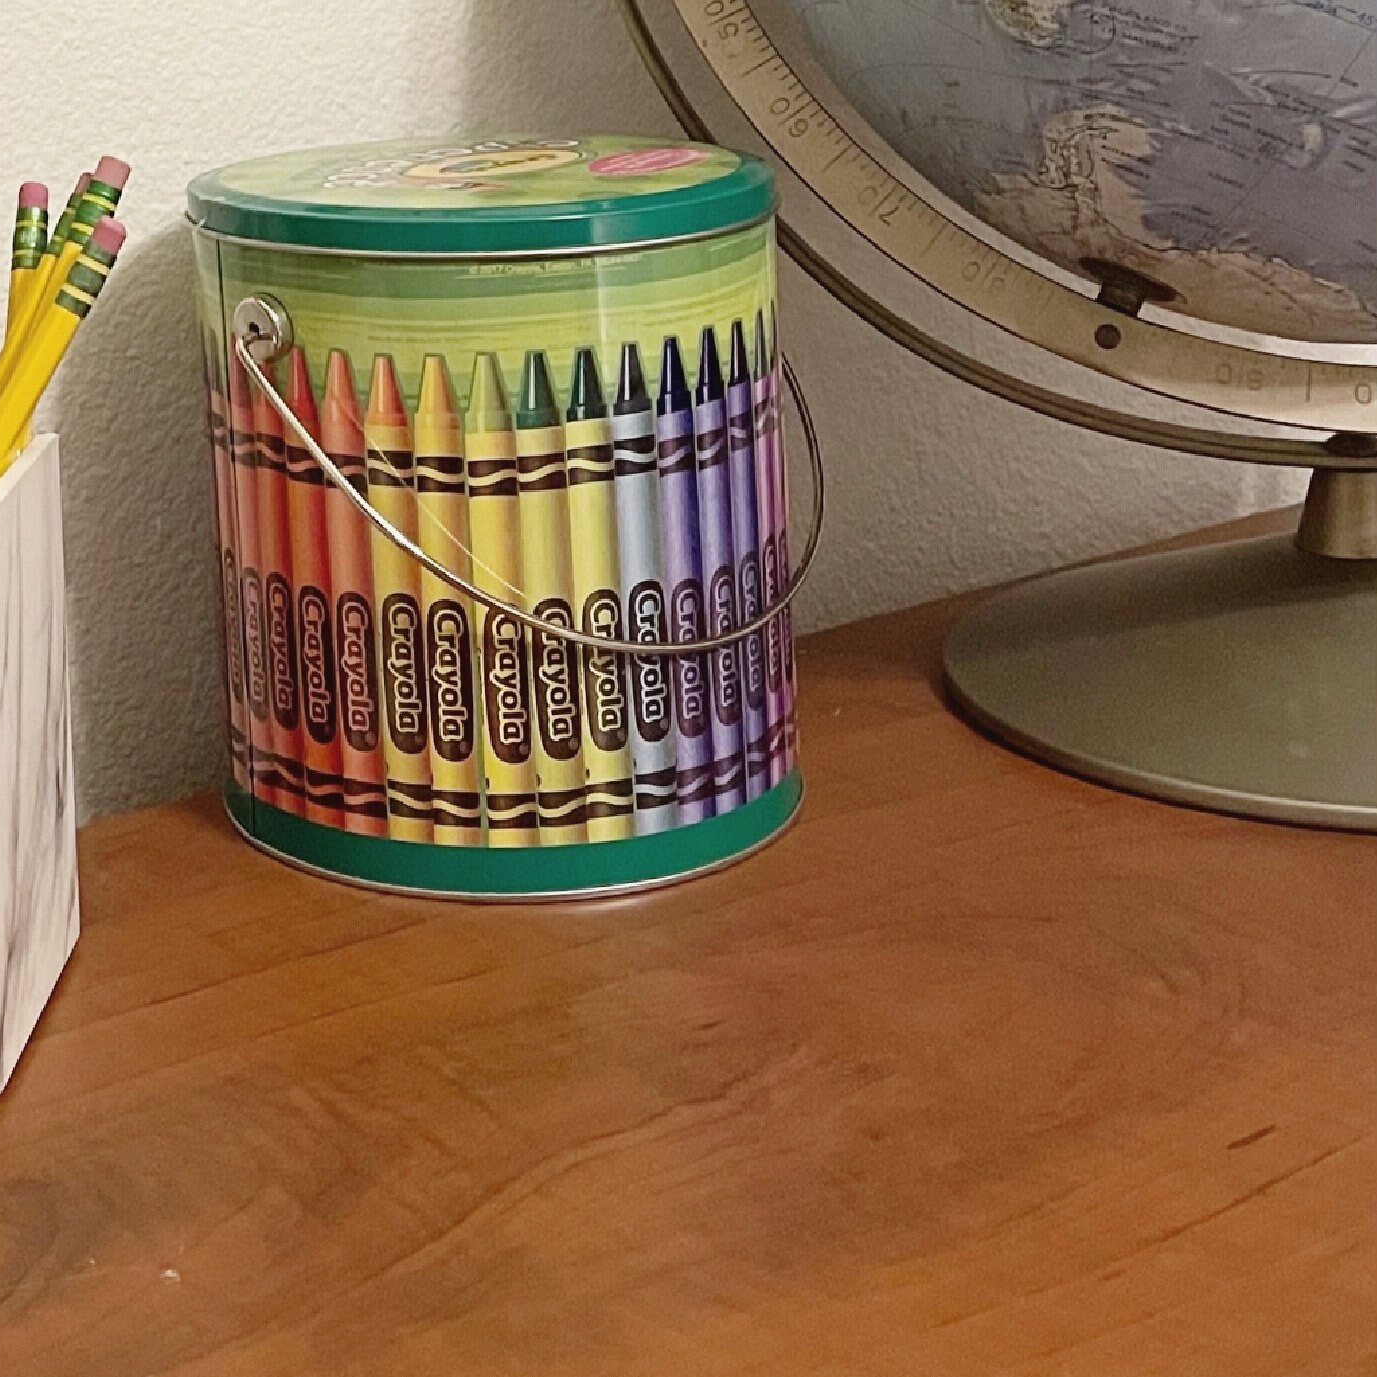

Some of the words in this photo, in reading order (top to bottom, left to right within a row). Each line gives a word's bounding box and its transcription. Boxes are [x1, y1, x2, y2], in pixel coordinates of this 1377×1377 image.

[769, 97, 810, 139] 60
[269, 582, 295, 710] Crayola
[302, 595, 332, 724] Crayola
[340, 600, 374, 733] Crayola
[386, 602, 423, 734] Crayola
[432, 609, 468, 743] Crayola
[490, 612, 528, 746] Crayola
[588, 597, 625, 732] Cryola
[714, 575, 739, 708] Craola
[742, 561, 762, 693] Craola
